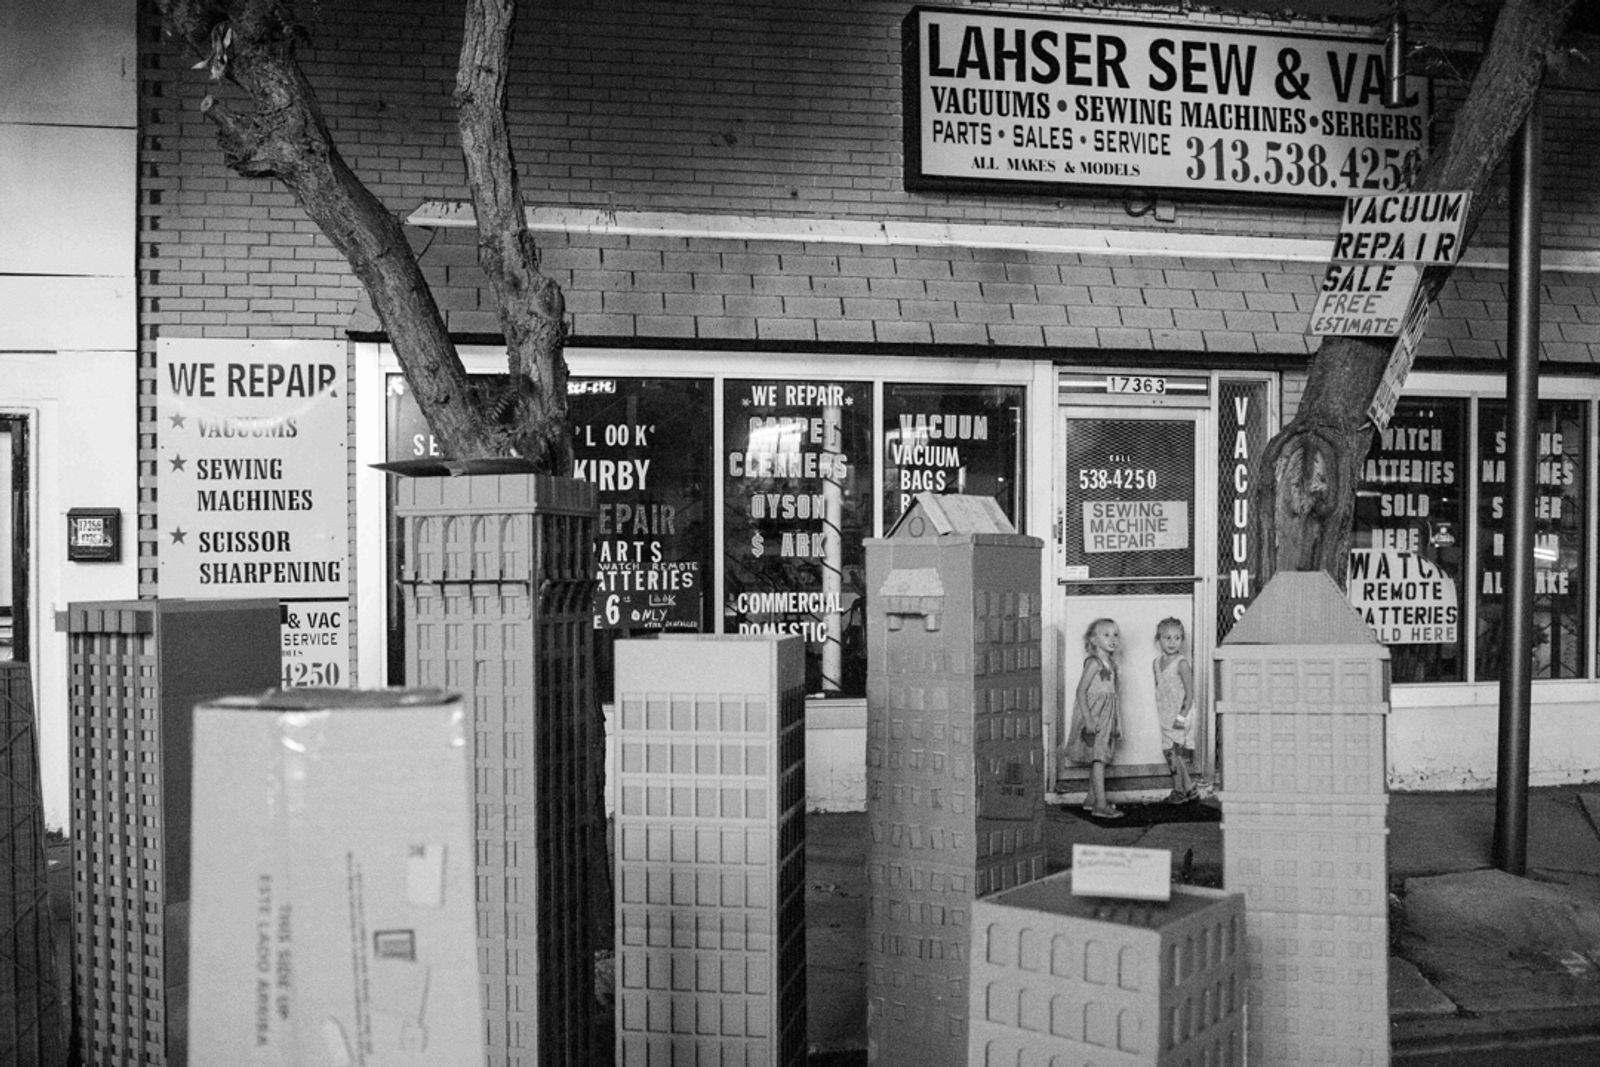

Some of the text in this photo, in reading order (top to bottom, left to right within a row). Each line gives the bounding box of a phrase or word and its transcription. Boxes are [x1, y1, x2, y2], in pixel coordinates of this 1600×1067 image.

[928, 23, 1131, 90] LAHSER
[1148, 38, 1257, 97] SEW
[1274, 47, 1310, 101] &
[931, 86, 1423, 141] VACUUMS SEWING MACHINES SERGERS
[932, 119, 1171, 156] PARTS SALES SERVICE
[971, 157, 1141, 177] ALL MAKES & MODELS
[1345, 194, 1461, 225] VACUUM
[1333, 232, 1457, 262] REPAIR
[1321, 265, 1394, 293] SALE
[1321, 294, 1377, 316] FREE
[1312, 316, 1402, 336] ESTIMATE
[168, 362, 338, 398] WE REPAIR
[1110, 377, 1166, 393] 17363
[751, 385, 845, 407] WE REPAIR
[899, 414, 989, 440] VACUUM
[729, 452, 848, 479] CLEANERS
[892, 444, 960, 467] VACUUM
[1109, 454, 1132, 462] CALL
[196, 458, 283, 481] SEWING
[573, 458, 651, 491] KIRBY
[900, 470, 947, 491] BAGS
[1079, 469, 1157, 490] 538-4250
[1360, 459, 1455, 484] ATTERIES
[196, 489, 314, 512] MACHINES
[1092, 502, 1163, 518] SEWING
[1381, 493, 1430, 517] SOLD
[599, 503, 676, 536] EPAIR
[1090, 518, 1168, 534] MACHINE
[199, 530, 292, 553] SCISSOR
[593, 541, 662, 563] ARTS
[1094, 534, 1156, 549] REPAIR
[199, 561, 341, 584] SHARPENING
[652, 562, 698, 571] REMOTE
[596, 570, 694, 591] ATTERIES
[1363, 582, 1443, 601] REMOTE
[737, 592, 844, 614] COMMERCIAL
[287, 611, 342, 629] & VAC
[630, 608, 667, 622] ONLY
[283, 632, 338, 647] SERVICE
[738, 621, 828, 643] DOMESTIC
[1410, 626, 1455, 642] HERE
